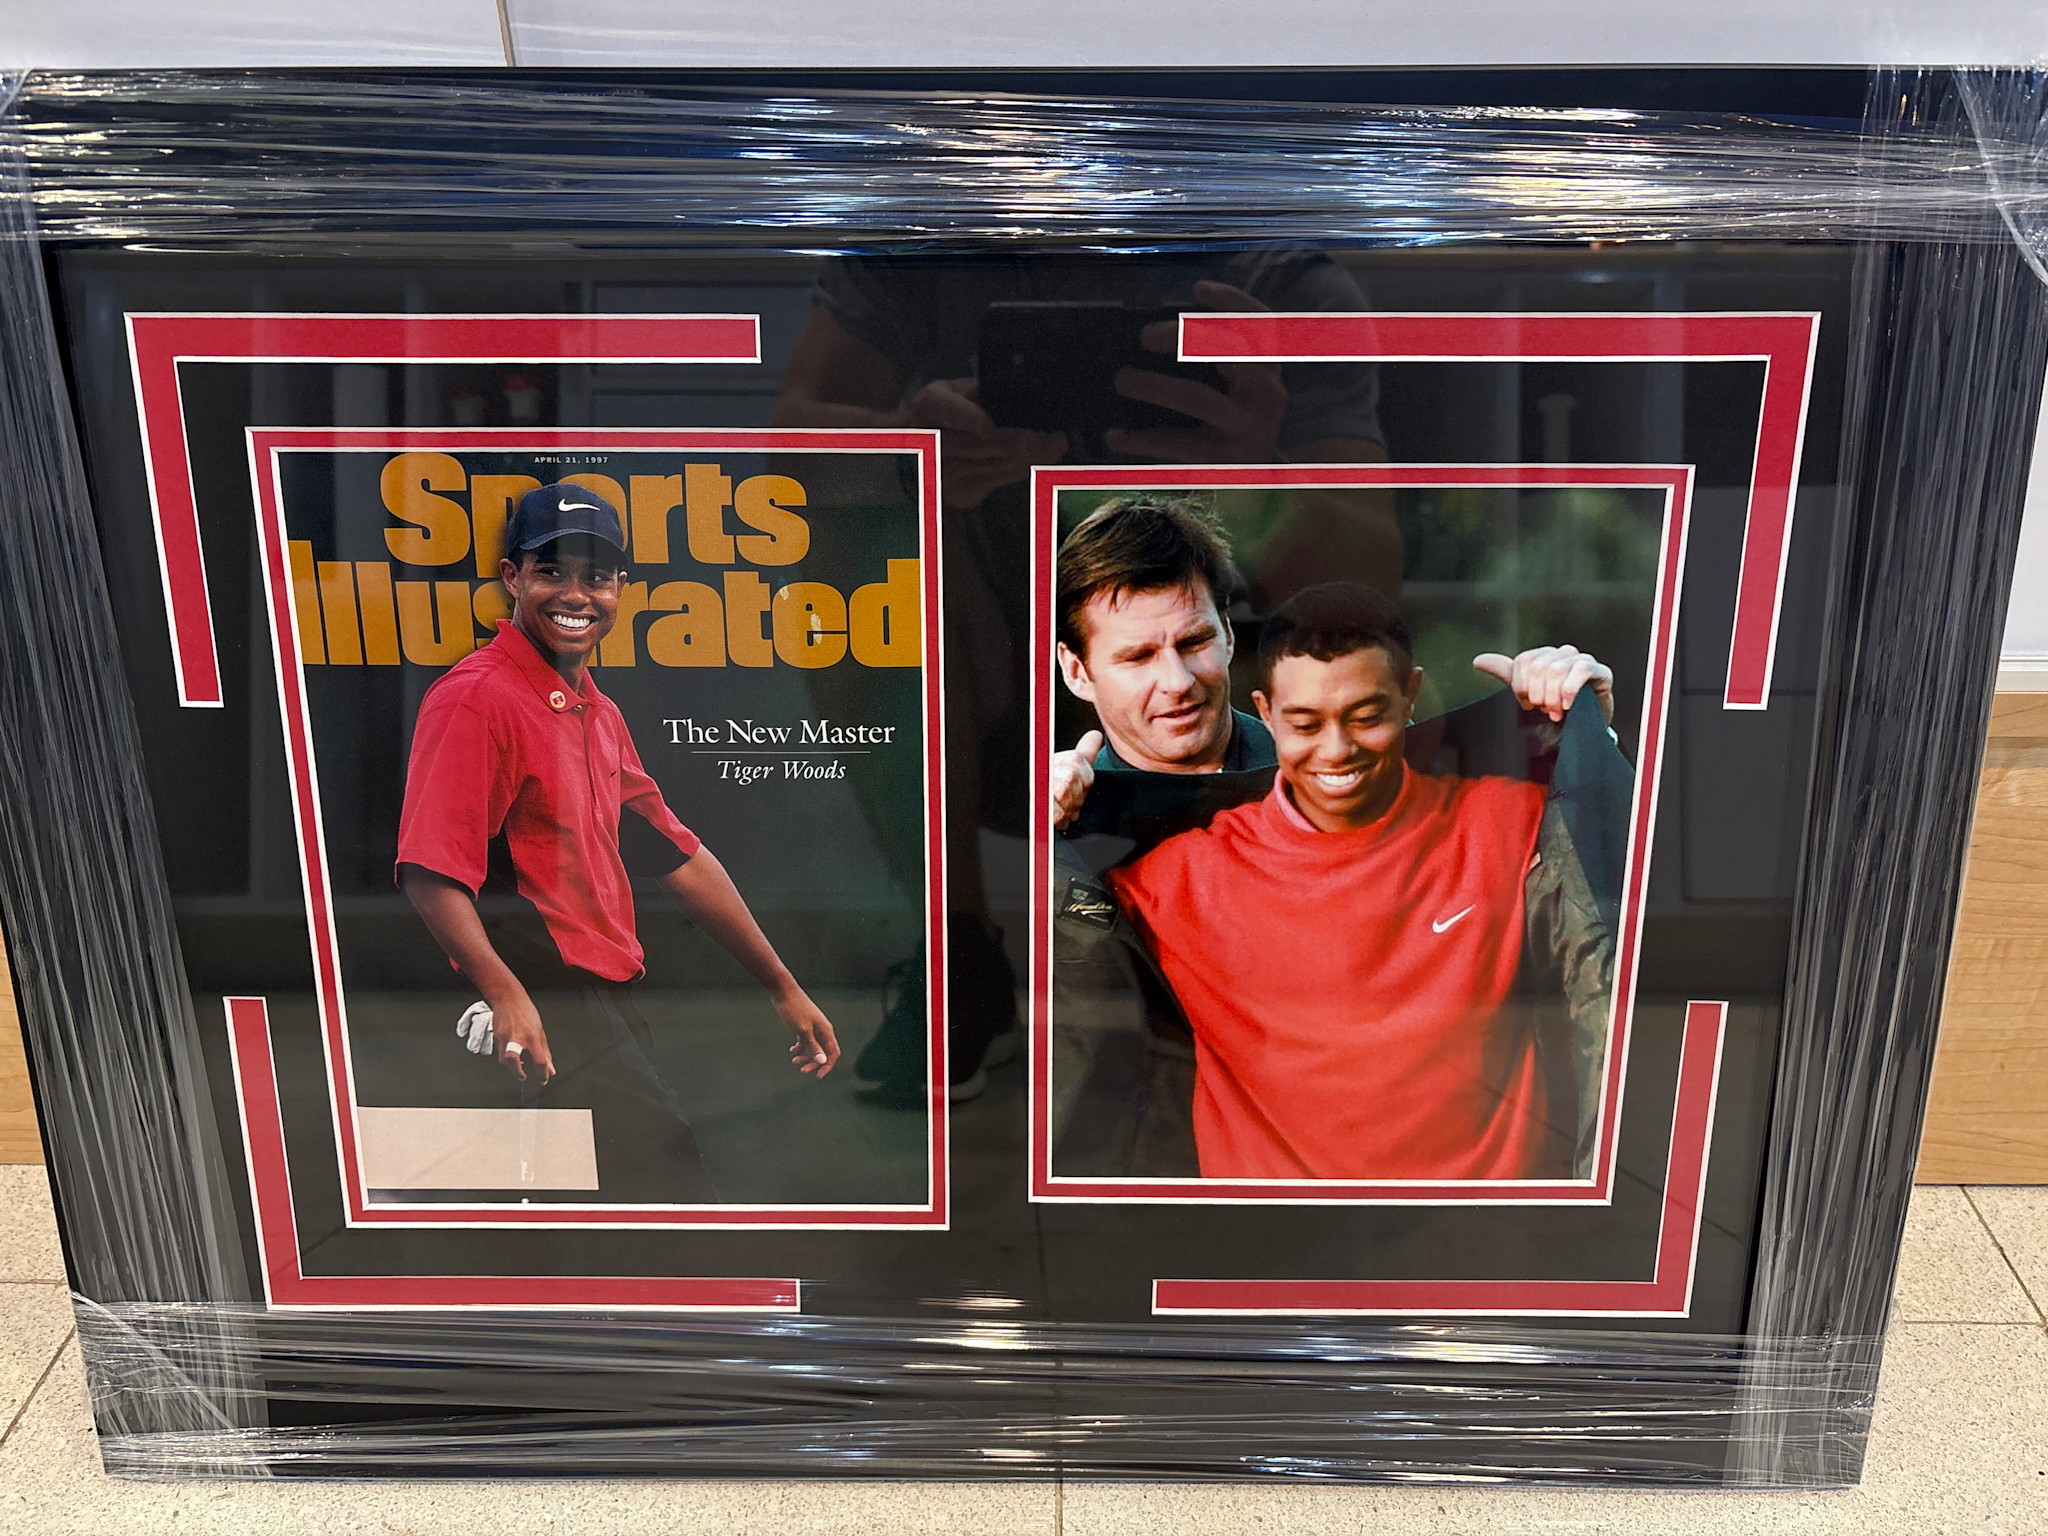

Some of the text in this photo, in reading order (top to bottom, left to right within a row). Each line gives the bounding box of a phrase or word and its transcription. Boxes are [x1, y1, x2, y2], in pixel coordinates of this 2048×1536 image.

[534, 456, 609, 465] APRIL 21, 1997
[662, 718, 896, 744] The New Master
[717, 759, 847, 786] Tiger Woods
